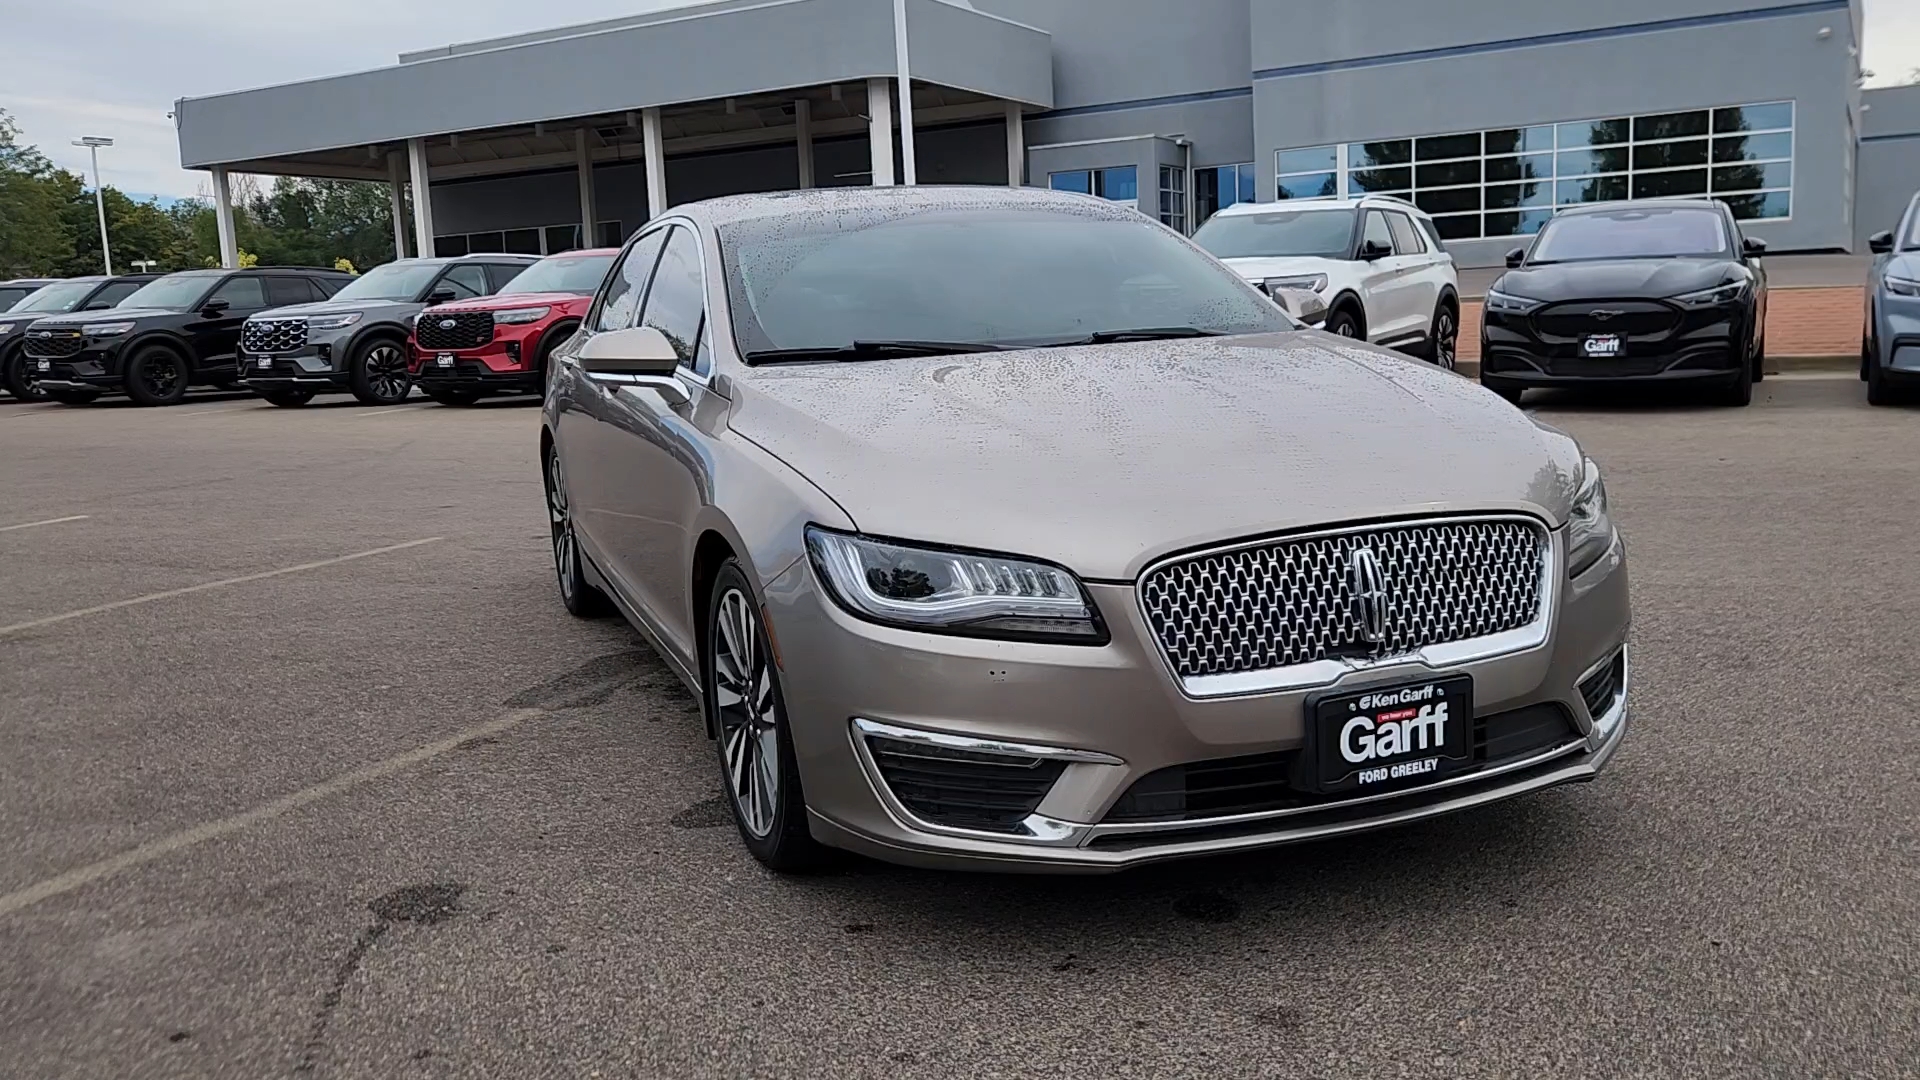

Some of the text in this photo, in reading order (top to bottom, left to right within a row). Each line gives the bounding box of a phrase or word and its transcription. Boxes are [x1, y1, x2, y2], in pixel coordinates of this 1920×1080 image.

[1584, 338, 1620, 352] Garff
[1371, 685, 1434, 709] Ken Garff
[1339, 701, 1448, 764] Garff
[1358, 758, 1439, 785] FORD GREELEY
